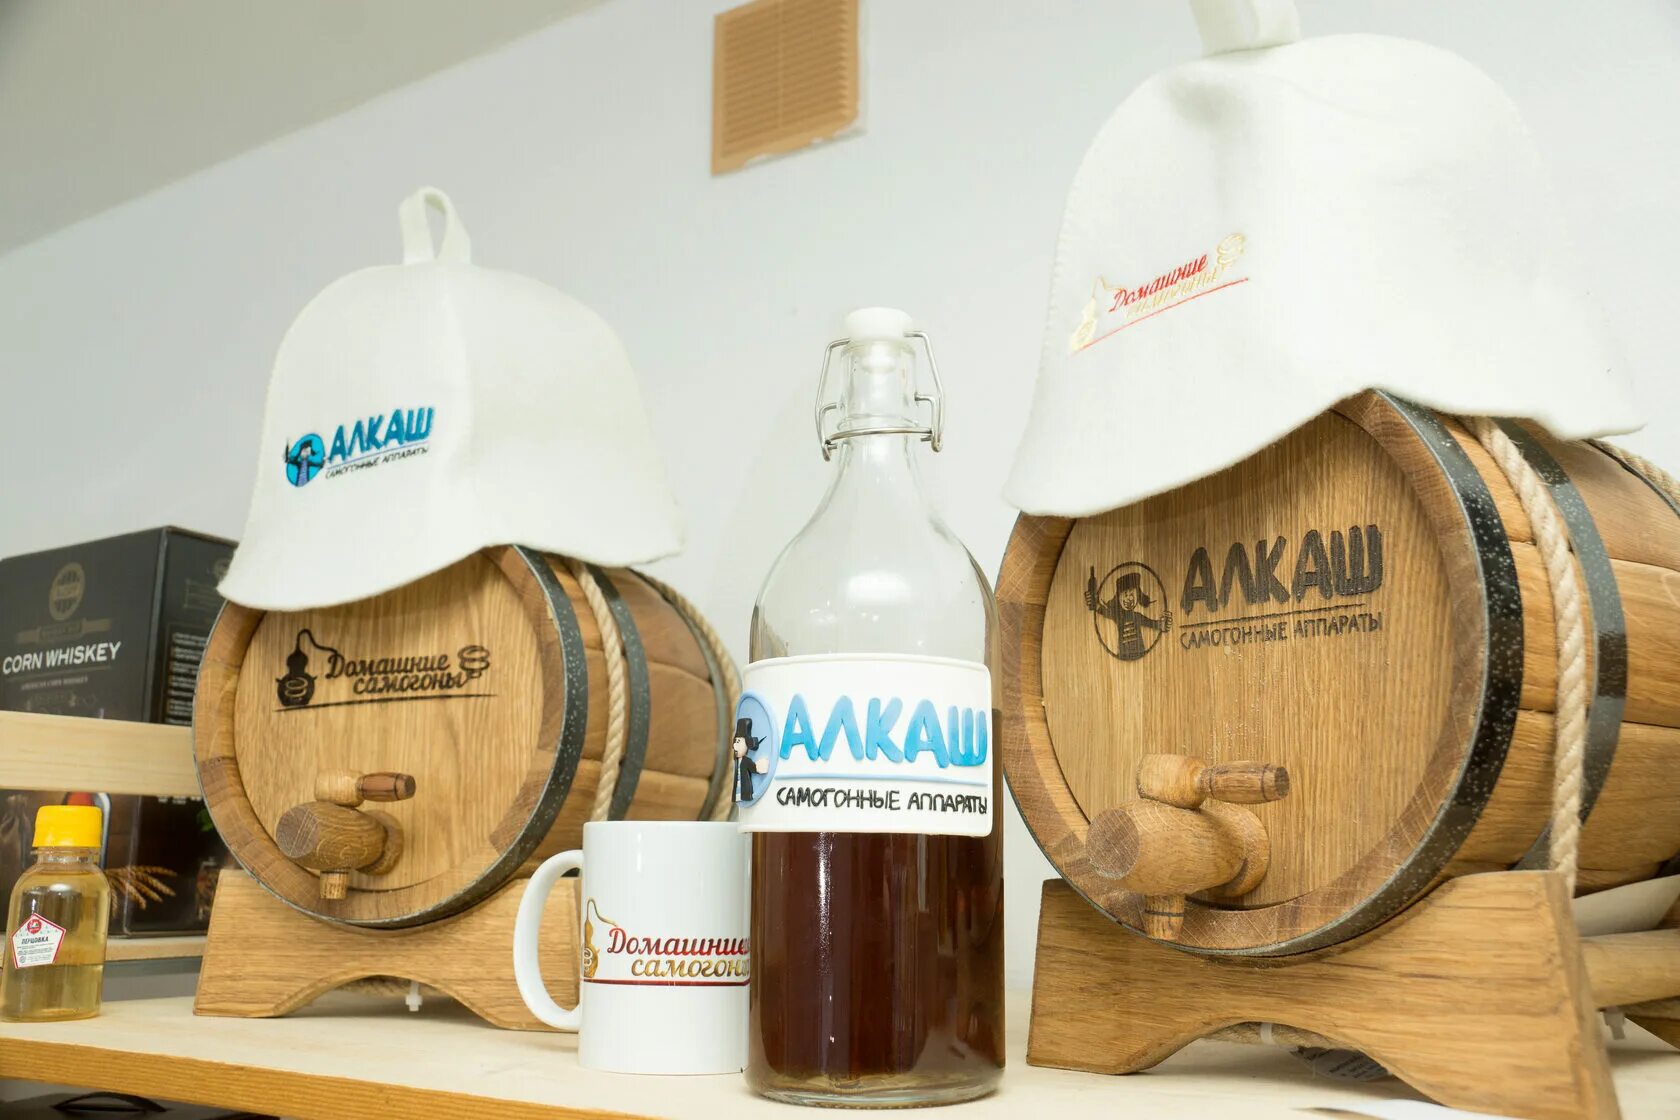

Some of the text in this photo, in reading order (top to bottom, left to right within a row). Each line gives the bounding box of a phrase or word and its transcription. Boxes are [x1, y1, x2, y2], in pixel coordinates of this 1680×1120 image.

[1109, 254, 1208, 312] Домашние
[328, 407, 434, 464] АЛКАШ
[1180, 524, 1384, 616] АЛКАШ
[1180, 611, 1384, 650] САМОГОННЫЕ АППАРАТЫ
[2, 641, 122, 675] CORN WHISKEY
[325, 653, 451, 680] Домашние
[353, 671, 464, 695] самогоны
[779, 693, 988, 768] АЛКАШ
[776, 787, 988, 814] САМОГОННЫЕ АППАРАТЫ
